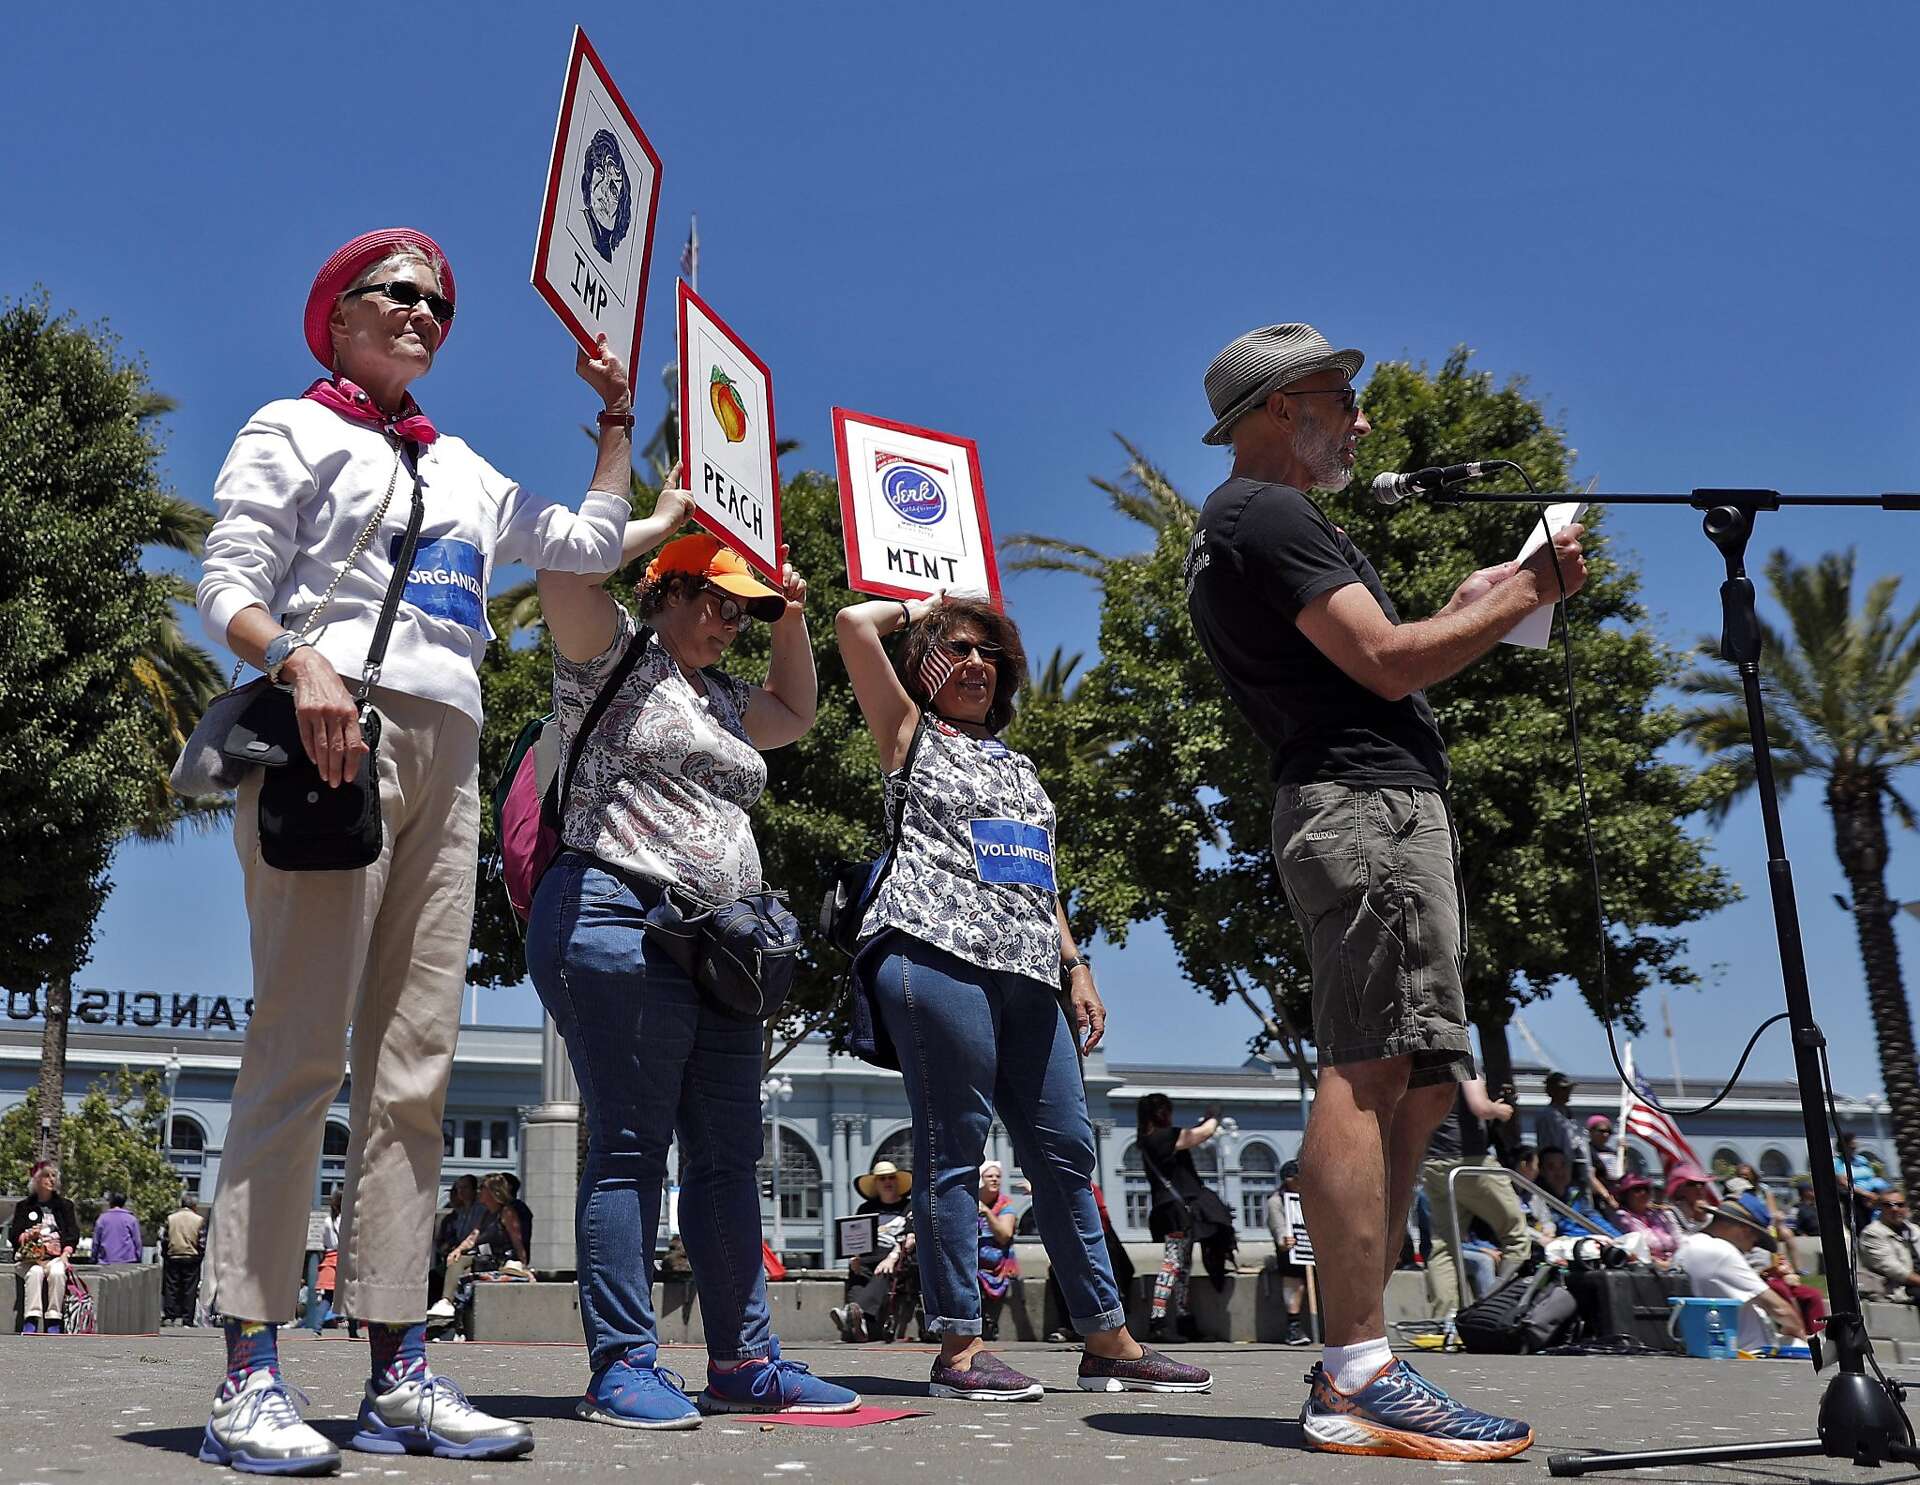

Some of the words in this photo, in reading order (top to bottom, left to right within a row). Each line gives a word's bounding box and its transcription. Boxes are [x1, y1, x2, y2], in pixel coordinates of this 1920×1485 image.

[571, 251, 607, 321] IMP
[704, 462, 763, 540] PEACH
[887, 546, 958, 582] MINT
[978, 843, 1051, 867] VOLUNTEER
